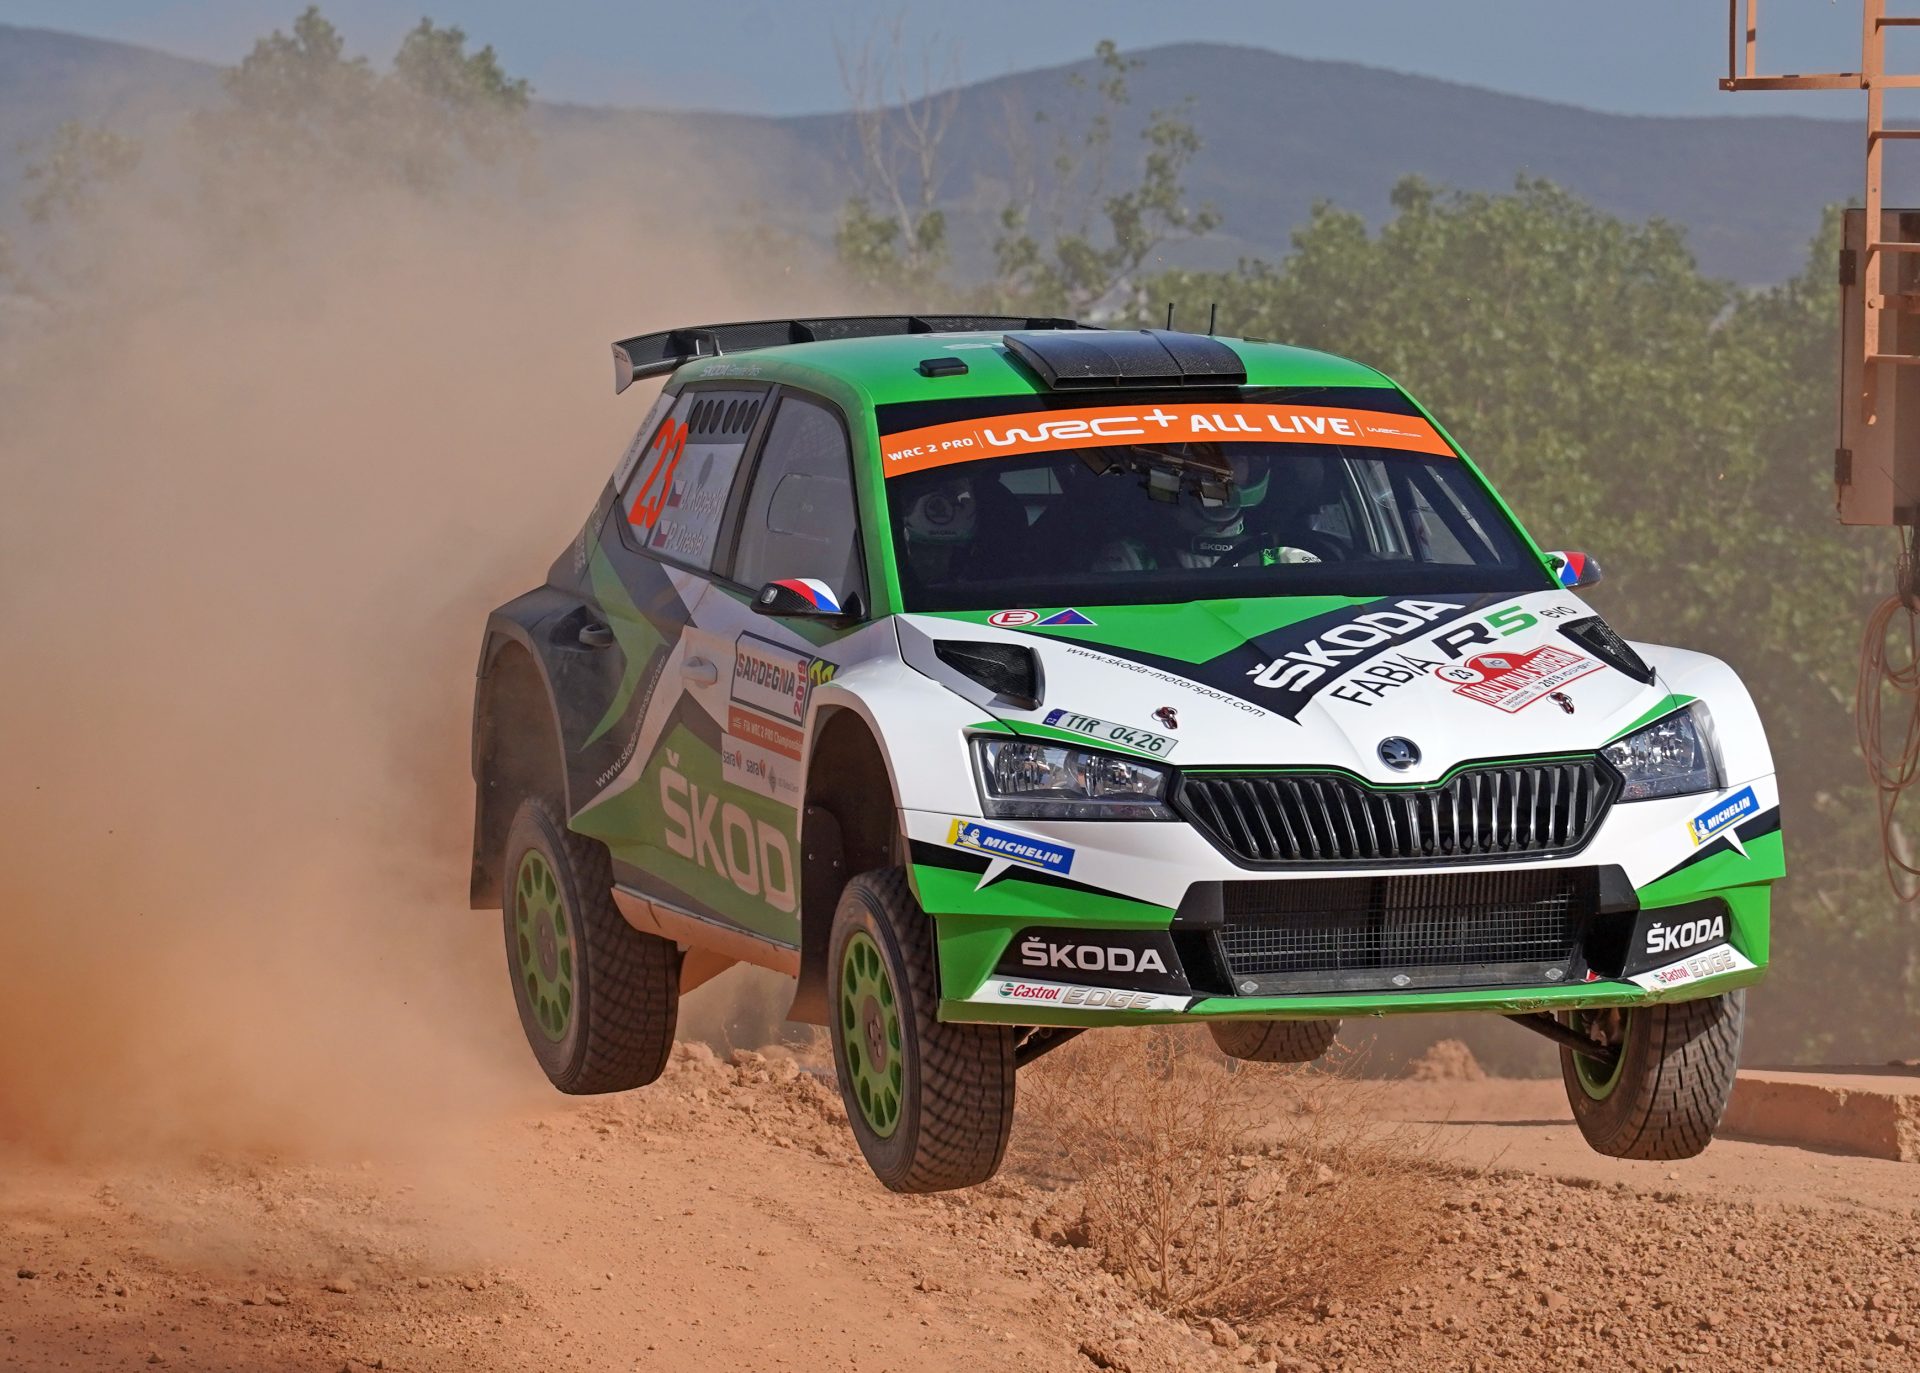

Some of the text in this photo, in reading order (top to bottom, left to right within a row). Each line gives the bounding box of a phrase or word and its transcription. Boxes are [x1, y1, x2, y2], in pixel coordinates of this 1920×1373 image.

[1190, 414, 1262, 433] ALL
[1267, 415, 1356, 436] LIVE
[888, 437, 974, 462] WRC 2 PRO
[627, 417, 689, 528] 23
[1000, 612, 1028, 623] E
[1246, 600, 1467, 693] ŠKODA
[1330, 652, 1448, 707] FABIA
[1431, 606, 1539, 660] R5
[736, 653, 796, 697] SARDEGNA
[794, 660, 807, 717] 2019
[1066, 646, 1266, 718] www.skoda-motorsport.com
[1449, 669, 1474, 681] 23
[1536, 674, 1565, 687] 2019
[1109, 727, 1166, 752] 0426
[1707, 796, 1750, 830] MICHELIN
[659, 747, 801, 921] ŠKOD
[983, 835, 1063, 865] MICHELIN
[1646, 915, 1724, 954] ŠKODA
[1021, 936, 1168, 974] ŠKODA
[1661, 949, 1736, 983] Castrol EDGE
[1013, 982, 1160, 1010] Castrol EDGE
